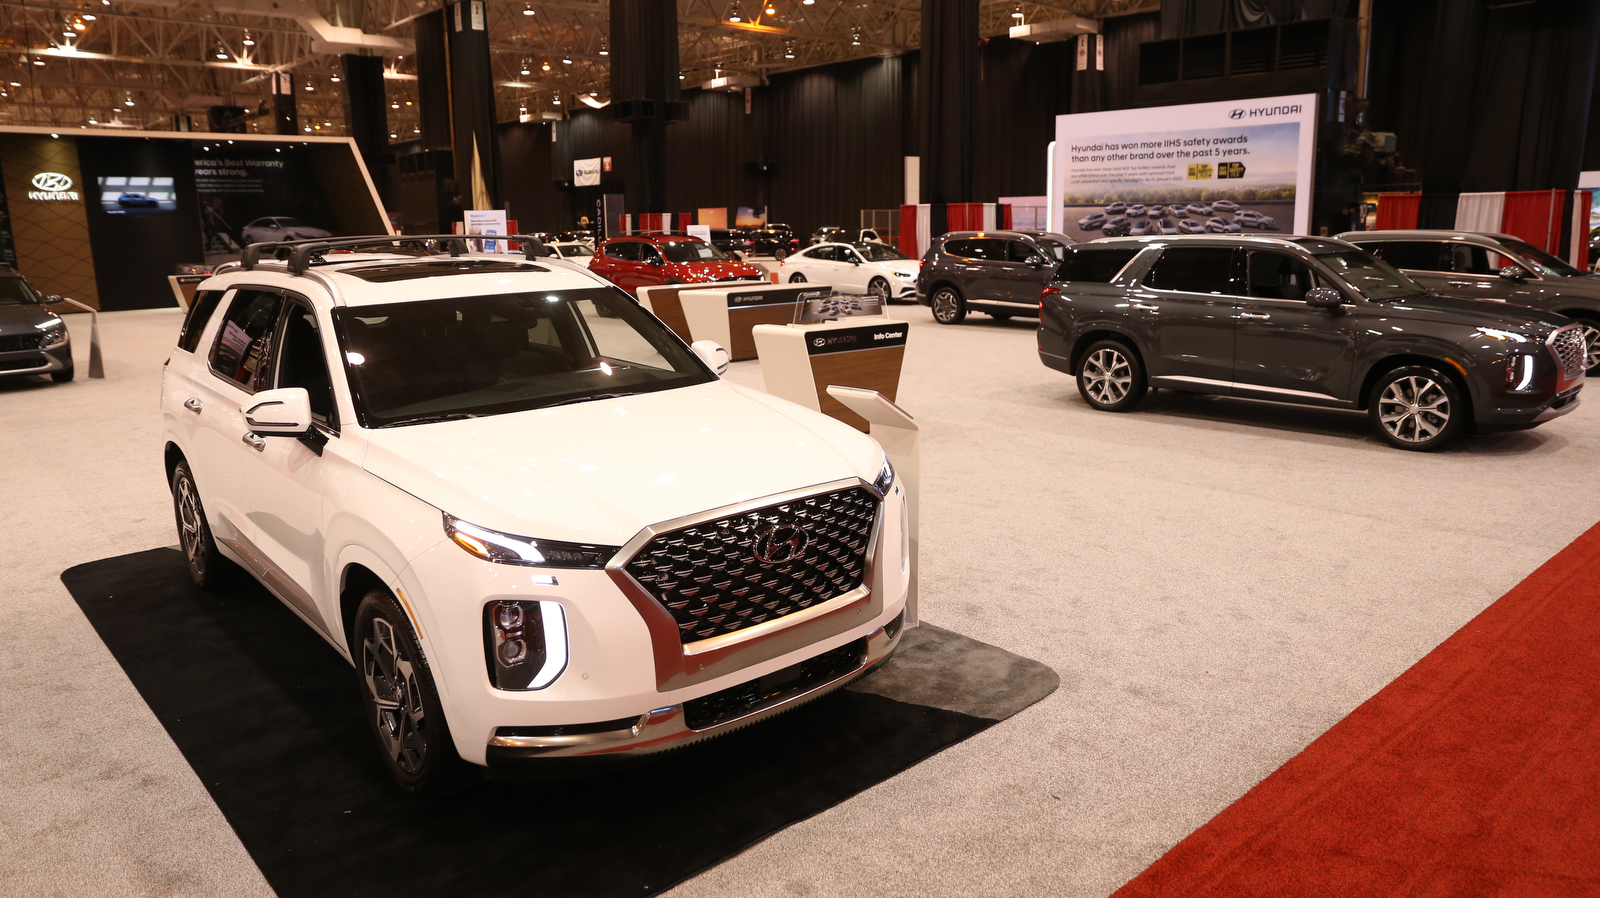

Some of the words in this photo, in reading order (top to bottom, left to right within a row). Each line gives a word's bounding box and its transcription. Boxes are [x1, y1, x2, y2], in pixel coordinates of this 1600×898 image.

[1250, 104, 1302, 118] HYUNDAI
[1071, 143, 1103, 154] Hyundai
[1105, 143, 1120, 151] has
[1140, 141, 1162, 149] more
[1164, 139, 1181, 148] IIHS
[1183, 137, 1210, 146] safety
[1212, 135, 1248, 144] awards
[1091, 155, 1106, 163] any
[1107, 153, 1128, 161] other
[1130, 151, 1154, 160] brand
[1156, 151, 1175, 159] over
[1177, 150, 1191, 158] the
[1192, 149, 1212, 158] past
[1214, 148, 1220, 156] 5
[1222, 147, 1250, 157] years.
[194, 158, 222, 166] erica's
[224, 158, 244, 166] Best
[244, 159, 284, 169] Warranty
[218, 168, 248, 177] strong.
[28, 191, 79, 201] HYUNDAI
[827, 335, 857, 345] HYUNDAI
[885, 331, 903, 339] Center
